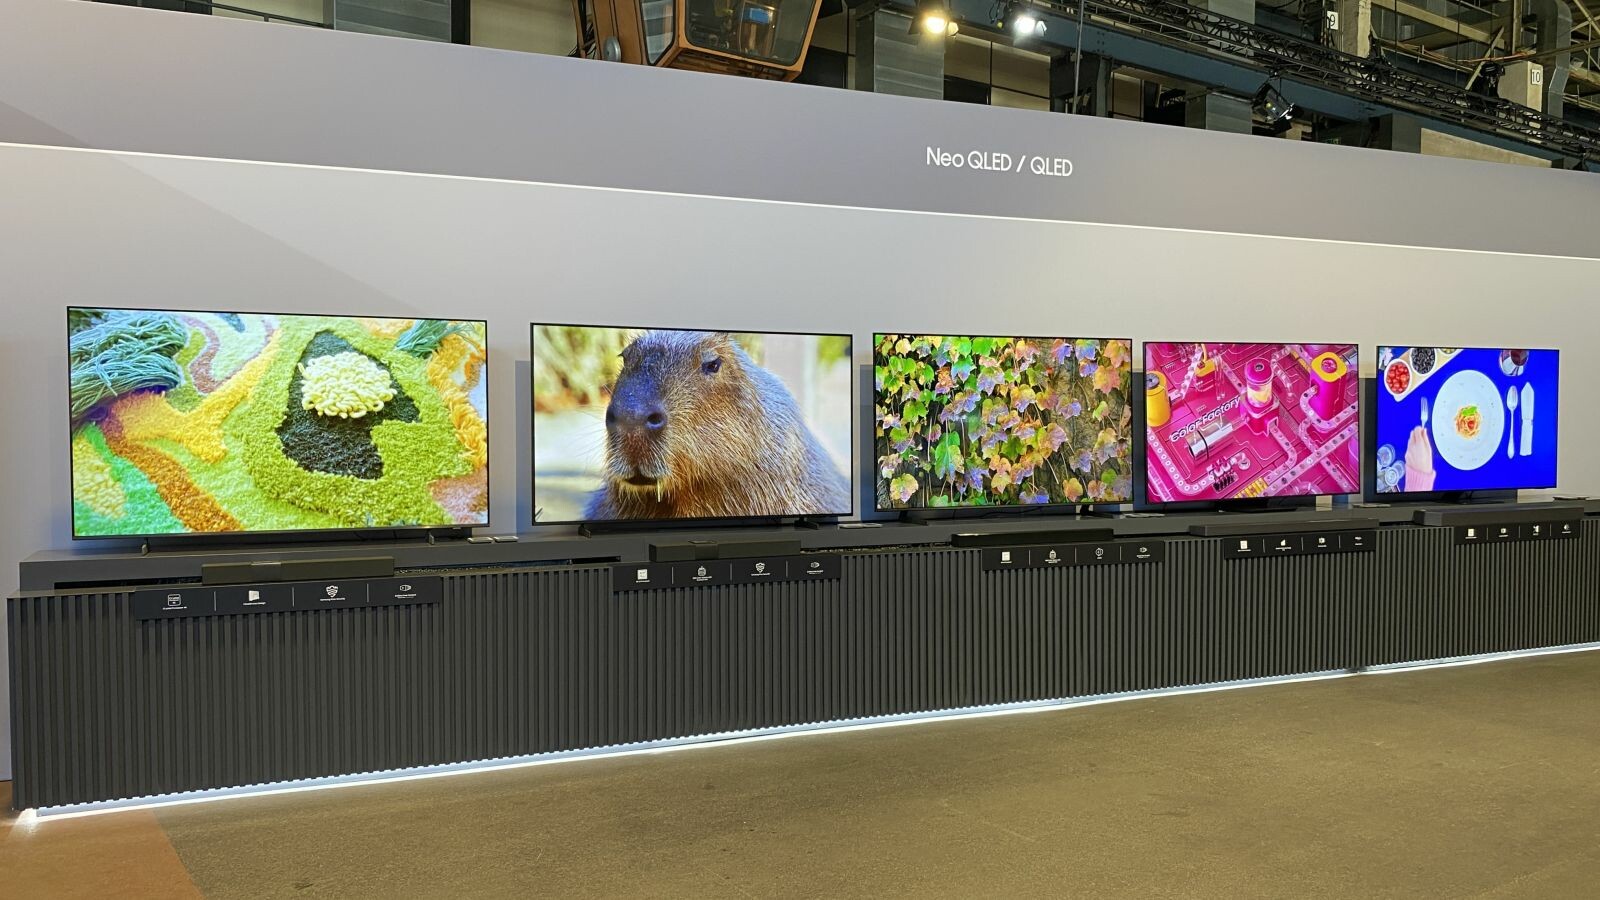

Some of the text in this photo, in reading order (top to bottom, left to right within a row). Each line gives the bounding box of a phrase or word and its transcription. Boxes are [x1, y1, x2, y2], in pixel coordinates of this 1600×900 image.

[1531, 71, 1541, 82] 10
[926, 146, 1074, 177] Neo QLED / QLED
[1169, 395, 1241, 442] Color Factory
